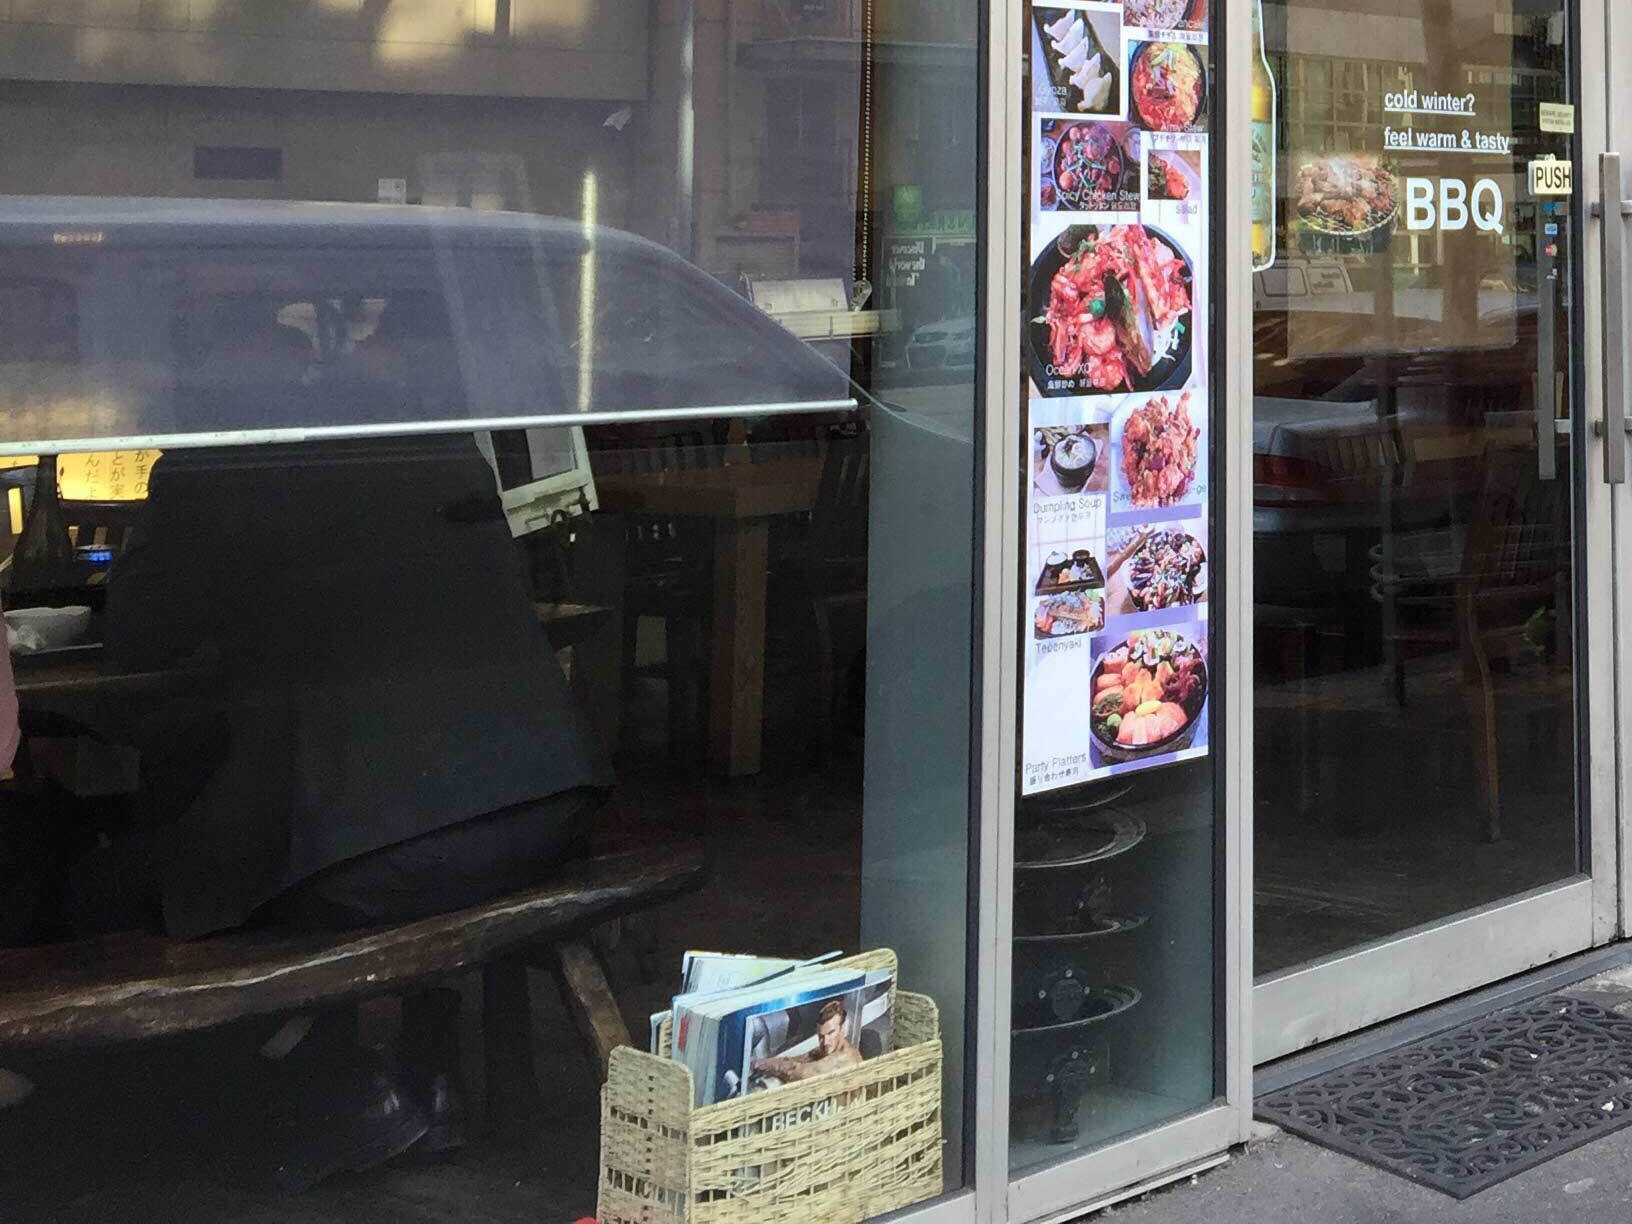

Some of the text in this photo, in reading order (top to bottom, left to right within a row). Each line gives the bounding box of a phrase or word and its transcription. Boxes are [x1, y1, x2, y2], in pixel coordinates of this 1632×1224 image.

[1385, 90, 1475, 111] cold winter?
[1384, 127, 1509, 154] feel warm & tasty
[1536, 167, 1572, 189] PUSH
[1406, 178, 1503, 234] BBQ
[1034, 497, 1102, 514] Dumpling Soup
